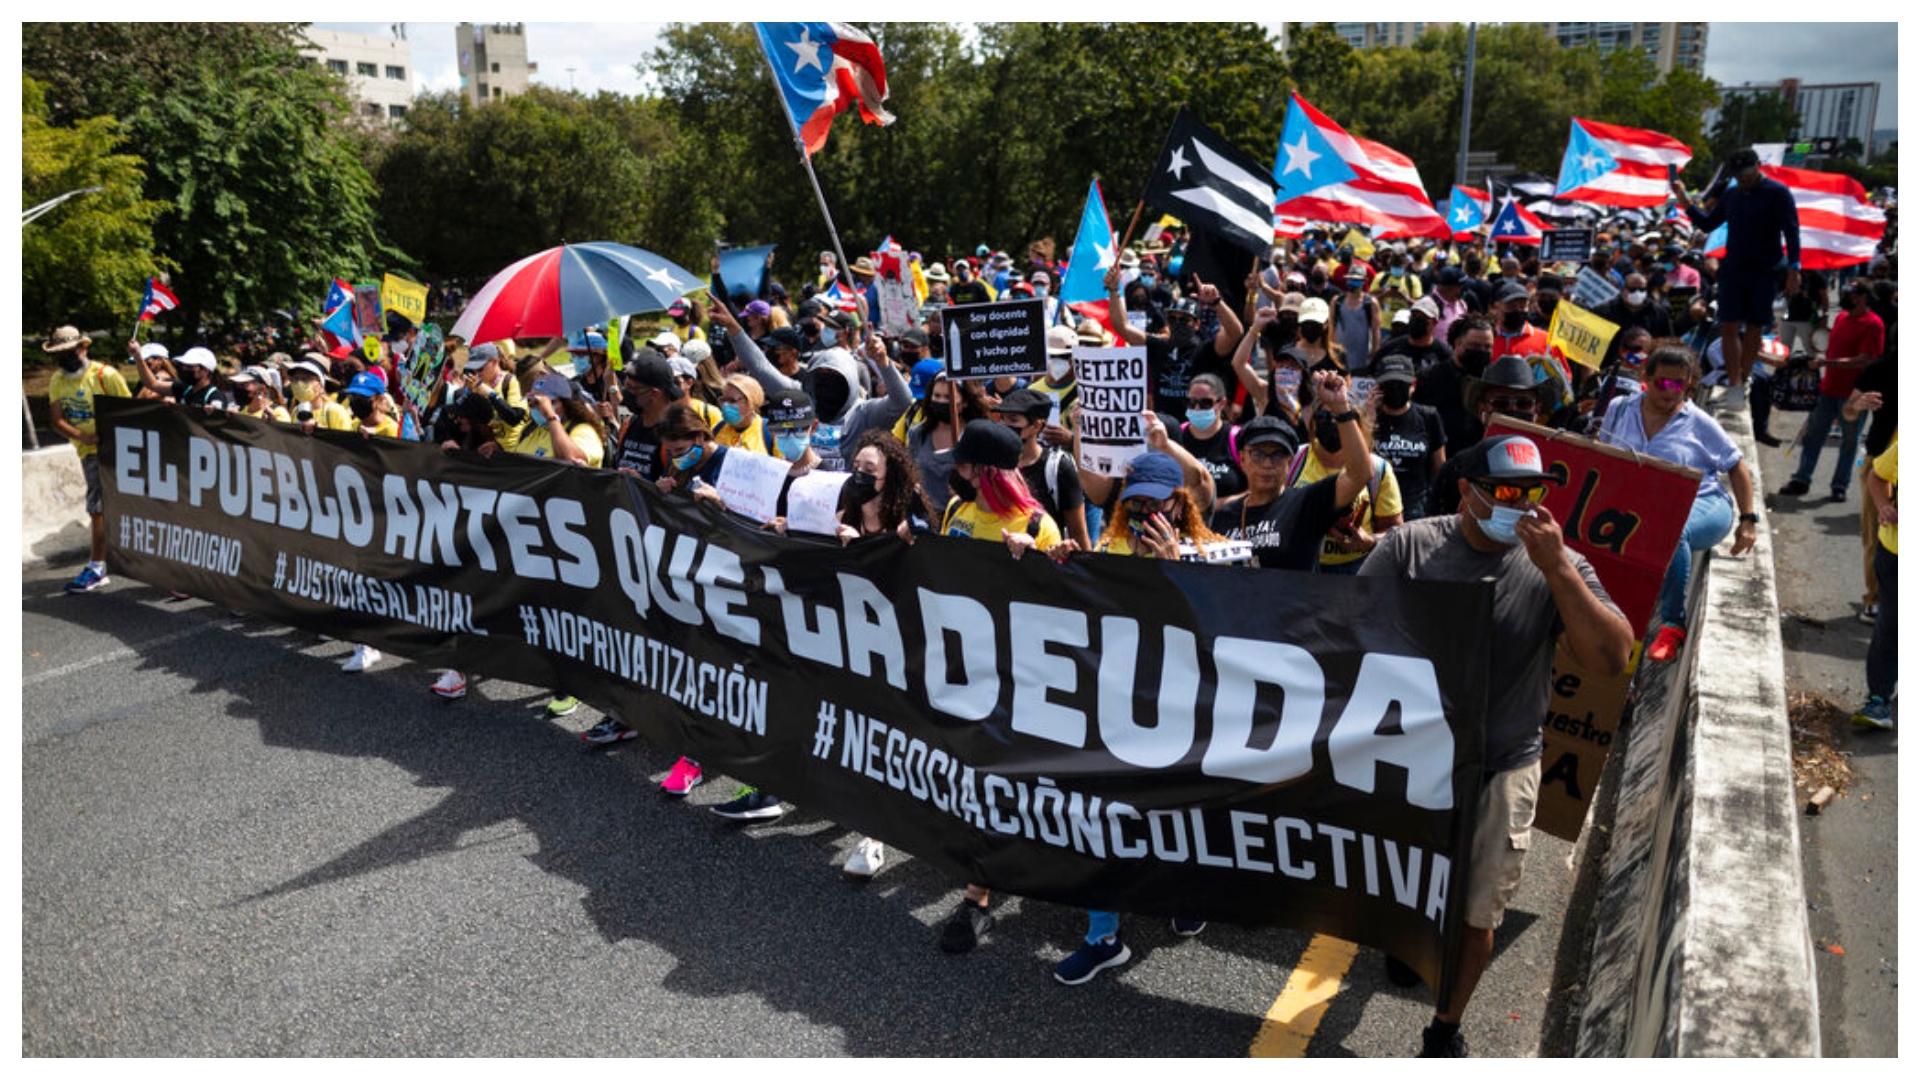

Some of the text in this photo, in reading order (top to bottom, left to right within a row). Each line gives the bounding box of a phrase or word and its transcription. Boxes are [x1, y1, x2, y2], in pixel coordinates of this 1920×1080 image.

[970, 309, 1027, 323] Soy docente
[970, 325, 1030, 340] con dignidad
[975, 345, 1026, 358] y lucho por
[970, 361, 1034, 374] mis derechos.
[1075, 358, 1143, 381] RETIRO
[115, 427, 178, 502] EL
[189, 436, 374, 547] PUEBLO
[382, 474, 600, 589] ANTES
[609, 507, 761, 646] QUE
[762, 565, 908, 691] LA
[917, 586, 1455, 810] DEUDA
[1551, 667, 1581, 698] e
[120, 514, 1452, 937] #RETIRODIGNO #JUSTICIASALARIAL #NOPRIVATIZACIÓN #NEGOCIACIÓNCOLECTIVA
